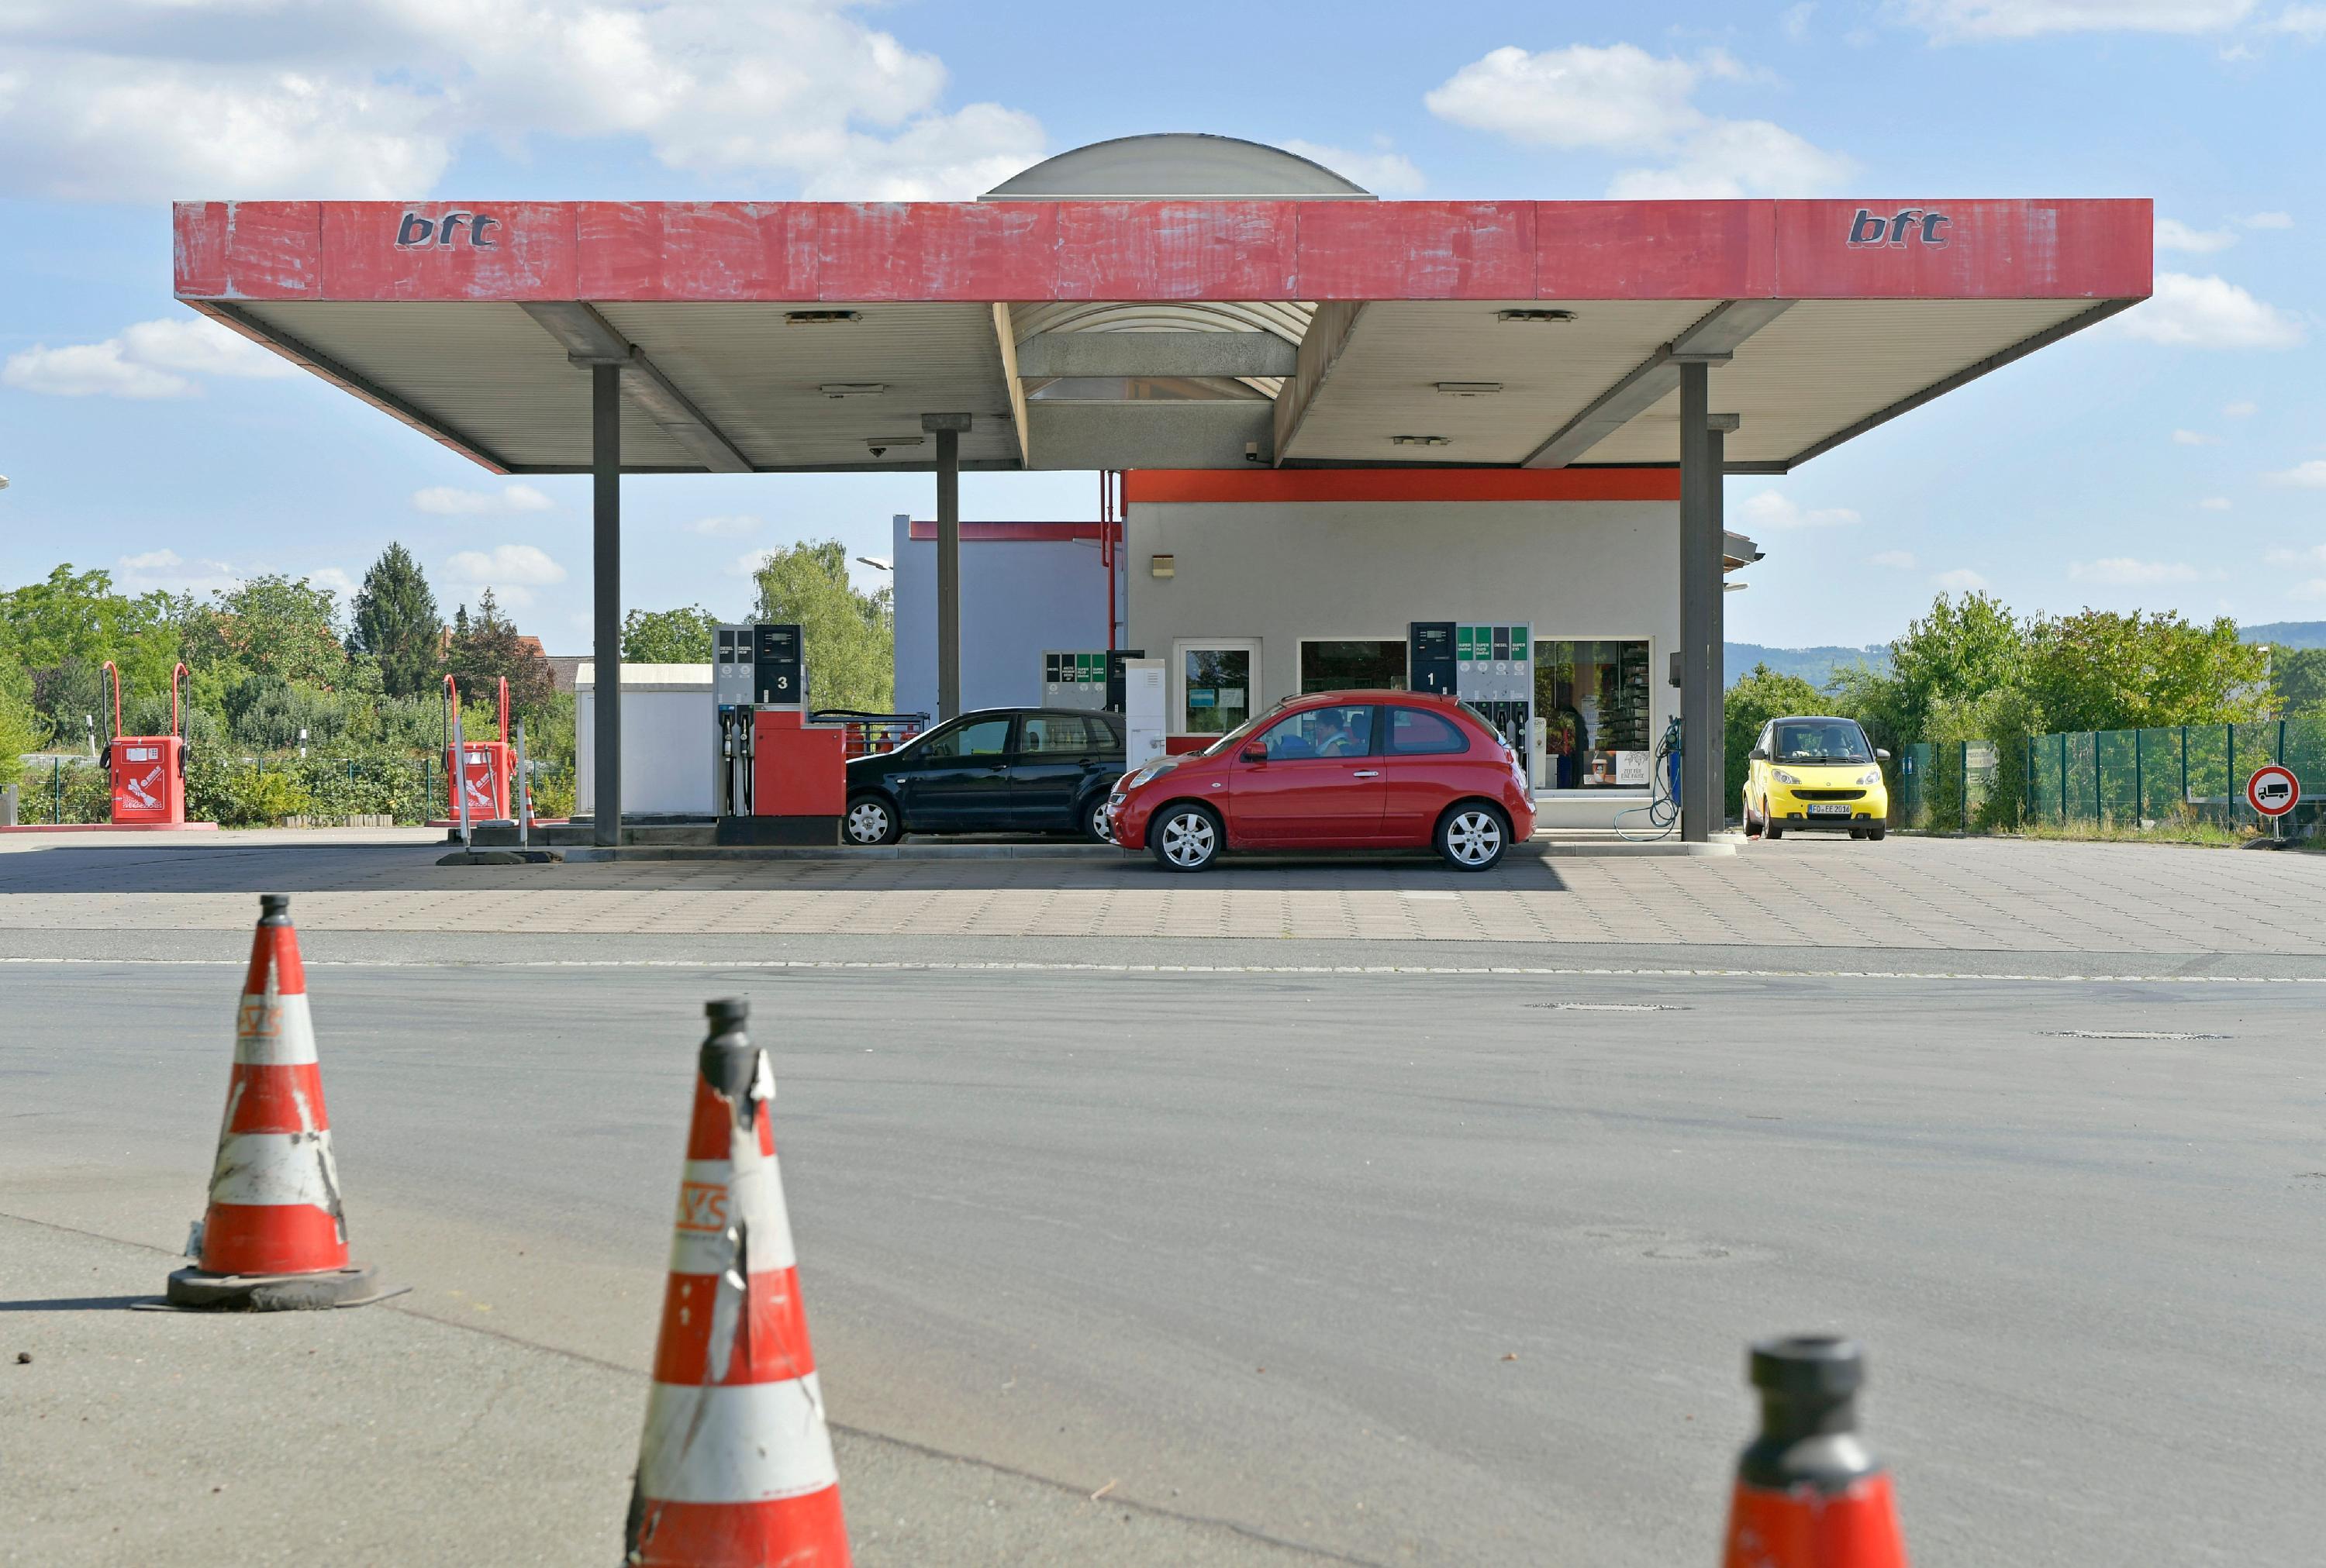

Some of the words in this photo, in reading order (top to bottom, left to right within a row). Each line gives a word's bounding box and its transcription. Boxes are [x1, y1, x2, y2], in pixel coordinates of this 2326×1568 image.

[394, 210, 502, 251] bft
[1846, 208, 1953, 250] bft
[778, 676, 788, 689] 3
[1427, 672, 1434, 685] 1
